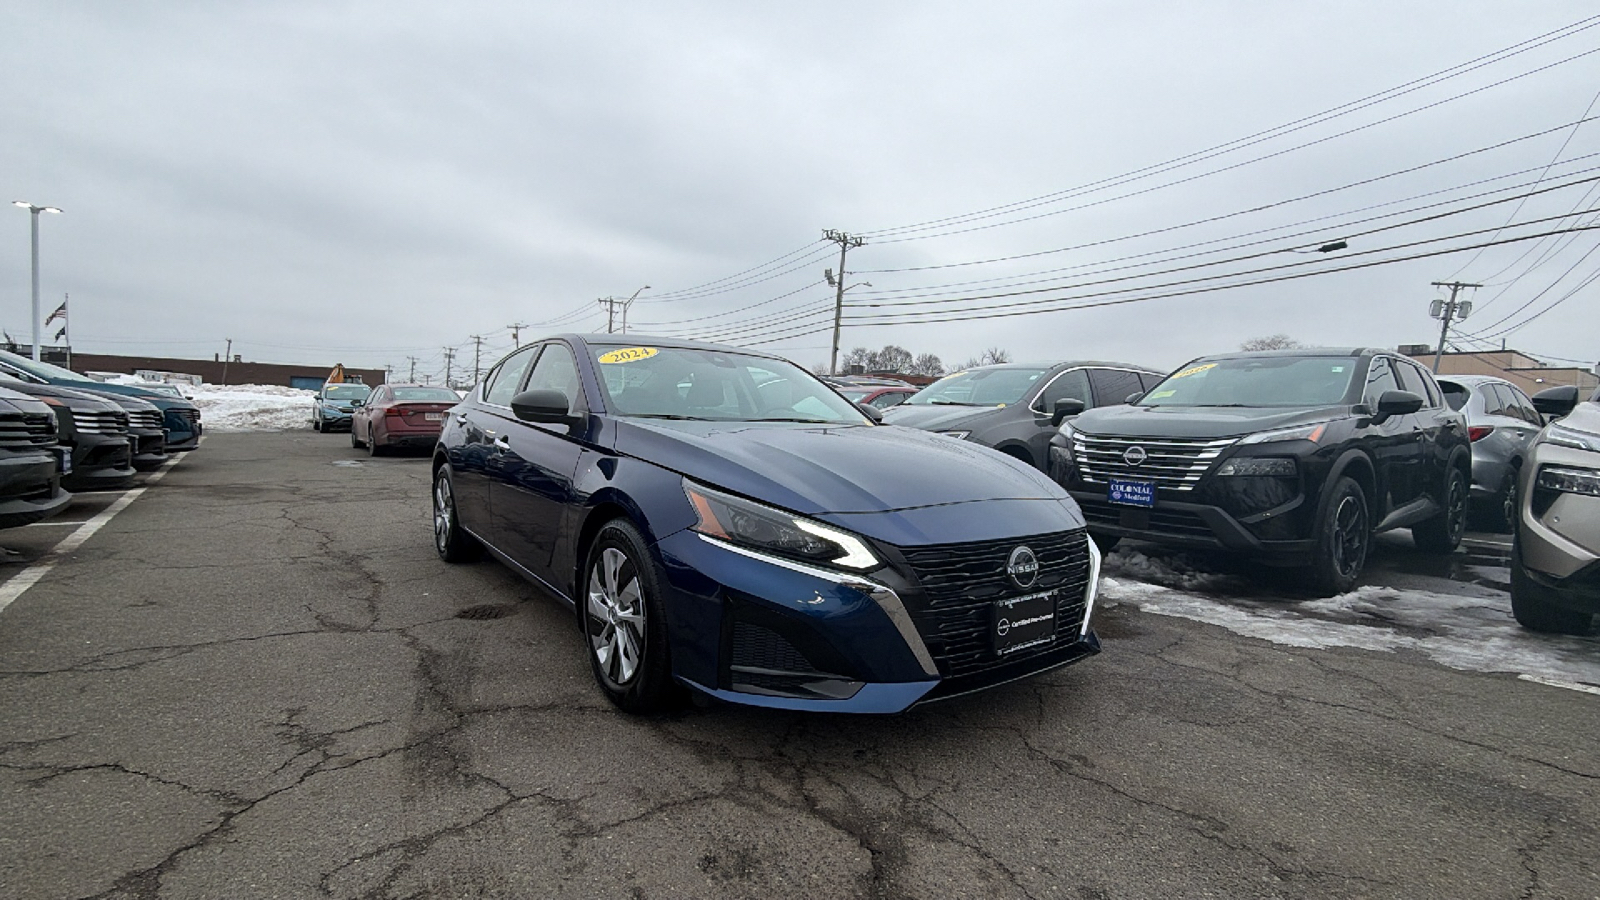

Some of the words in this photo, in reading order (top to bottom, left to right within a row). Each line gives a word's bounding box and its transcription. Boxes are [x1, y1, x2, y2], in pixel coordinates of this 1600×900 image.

[610, 348, 650, 362] 2024
[1123, 492, 1151, 502] Medford
[1007, 563, 1039, 574] NISSAN
